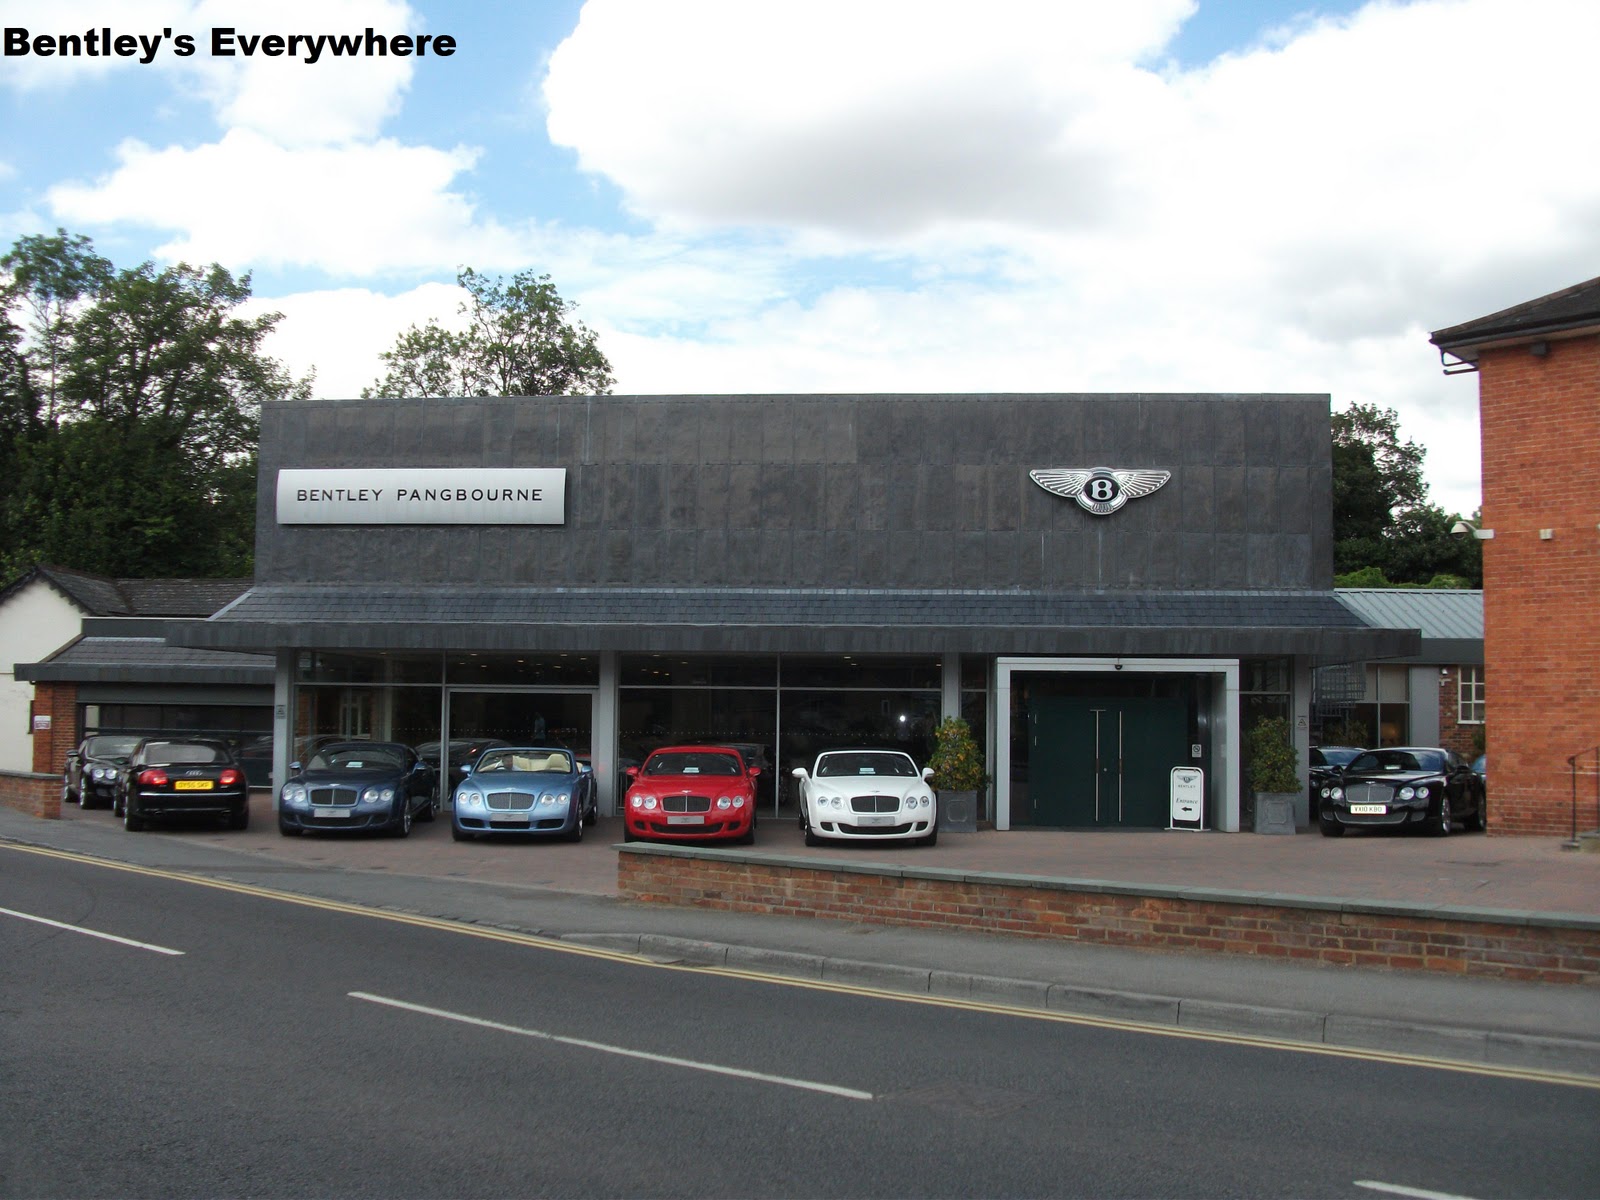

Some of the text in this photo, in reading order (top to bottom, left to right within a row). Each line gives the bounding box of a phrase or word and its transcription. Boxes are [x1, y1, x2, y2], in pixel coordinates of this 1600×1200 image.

[296, 488, 543, 502] BENTLEY PANGBOURNE
[1091, 479, 1113, 500] B
